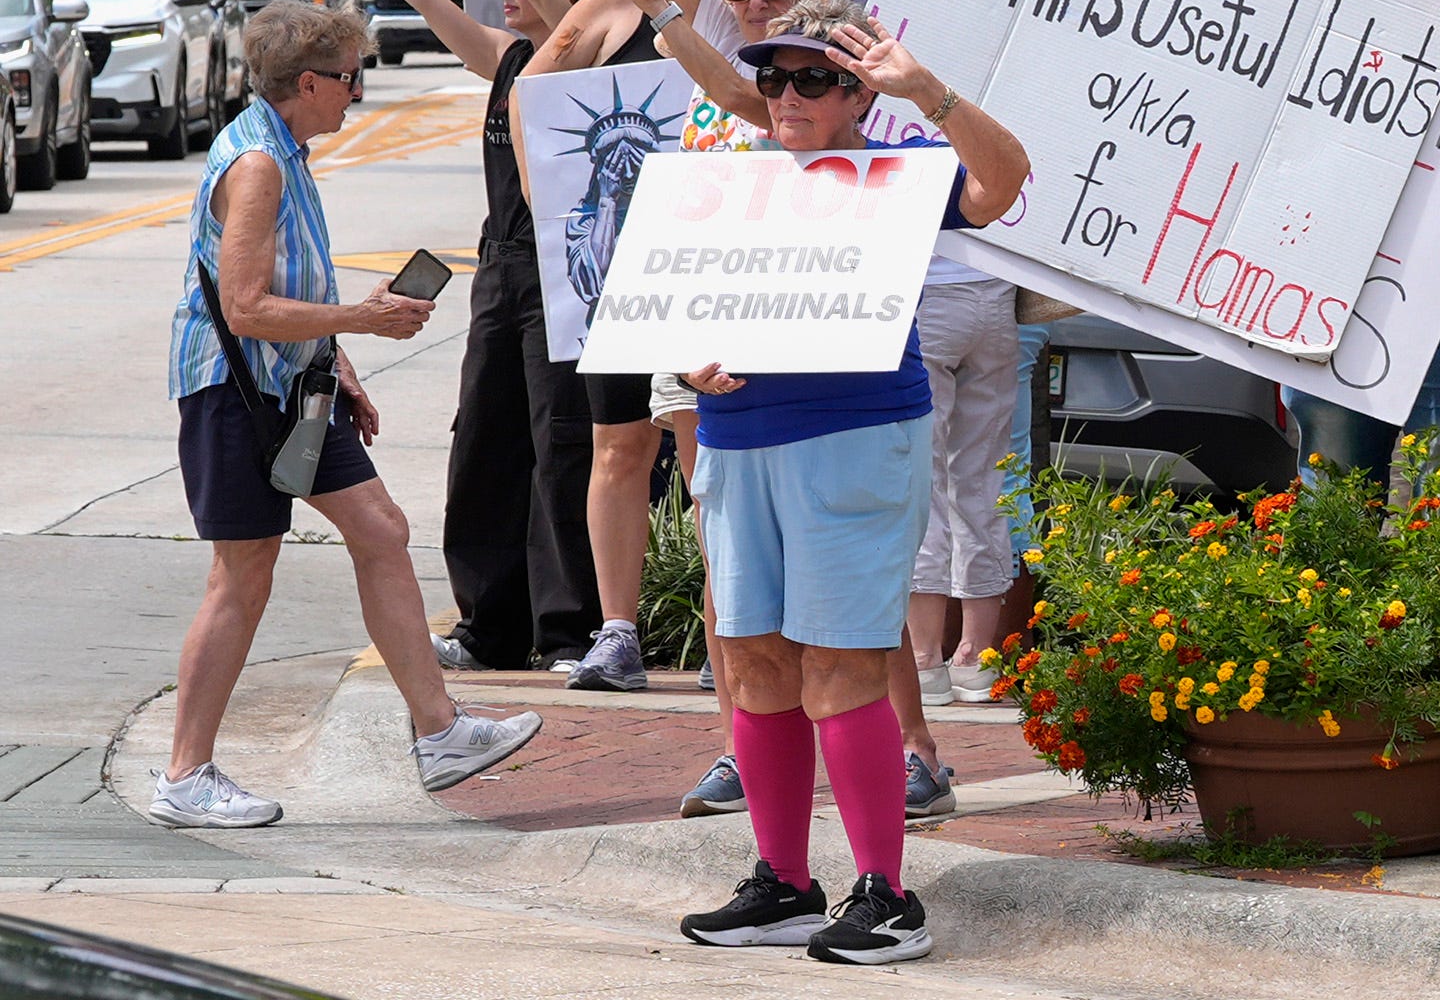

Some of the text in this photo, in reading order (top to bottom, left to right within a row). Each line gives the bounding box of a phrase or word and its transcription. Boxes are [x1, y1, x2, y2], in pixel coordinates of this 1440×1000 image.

[1087, 72, 1197, 148] a/k/a
[672, 155, 922, 222] STOP
[642, 245, 862, 274] DEPORTING
[1061, 140, 1349, 347] for Hamas
[597, 293, 905, 321] NON CRIMINALS
